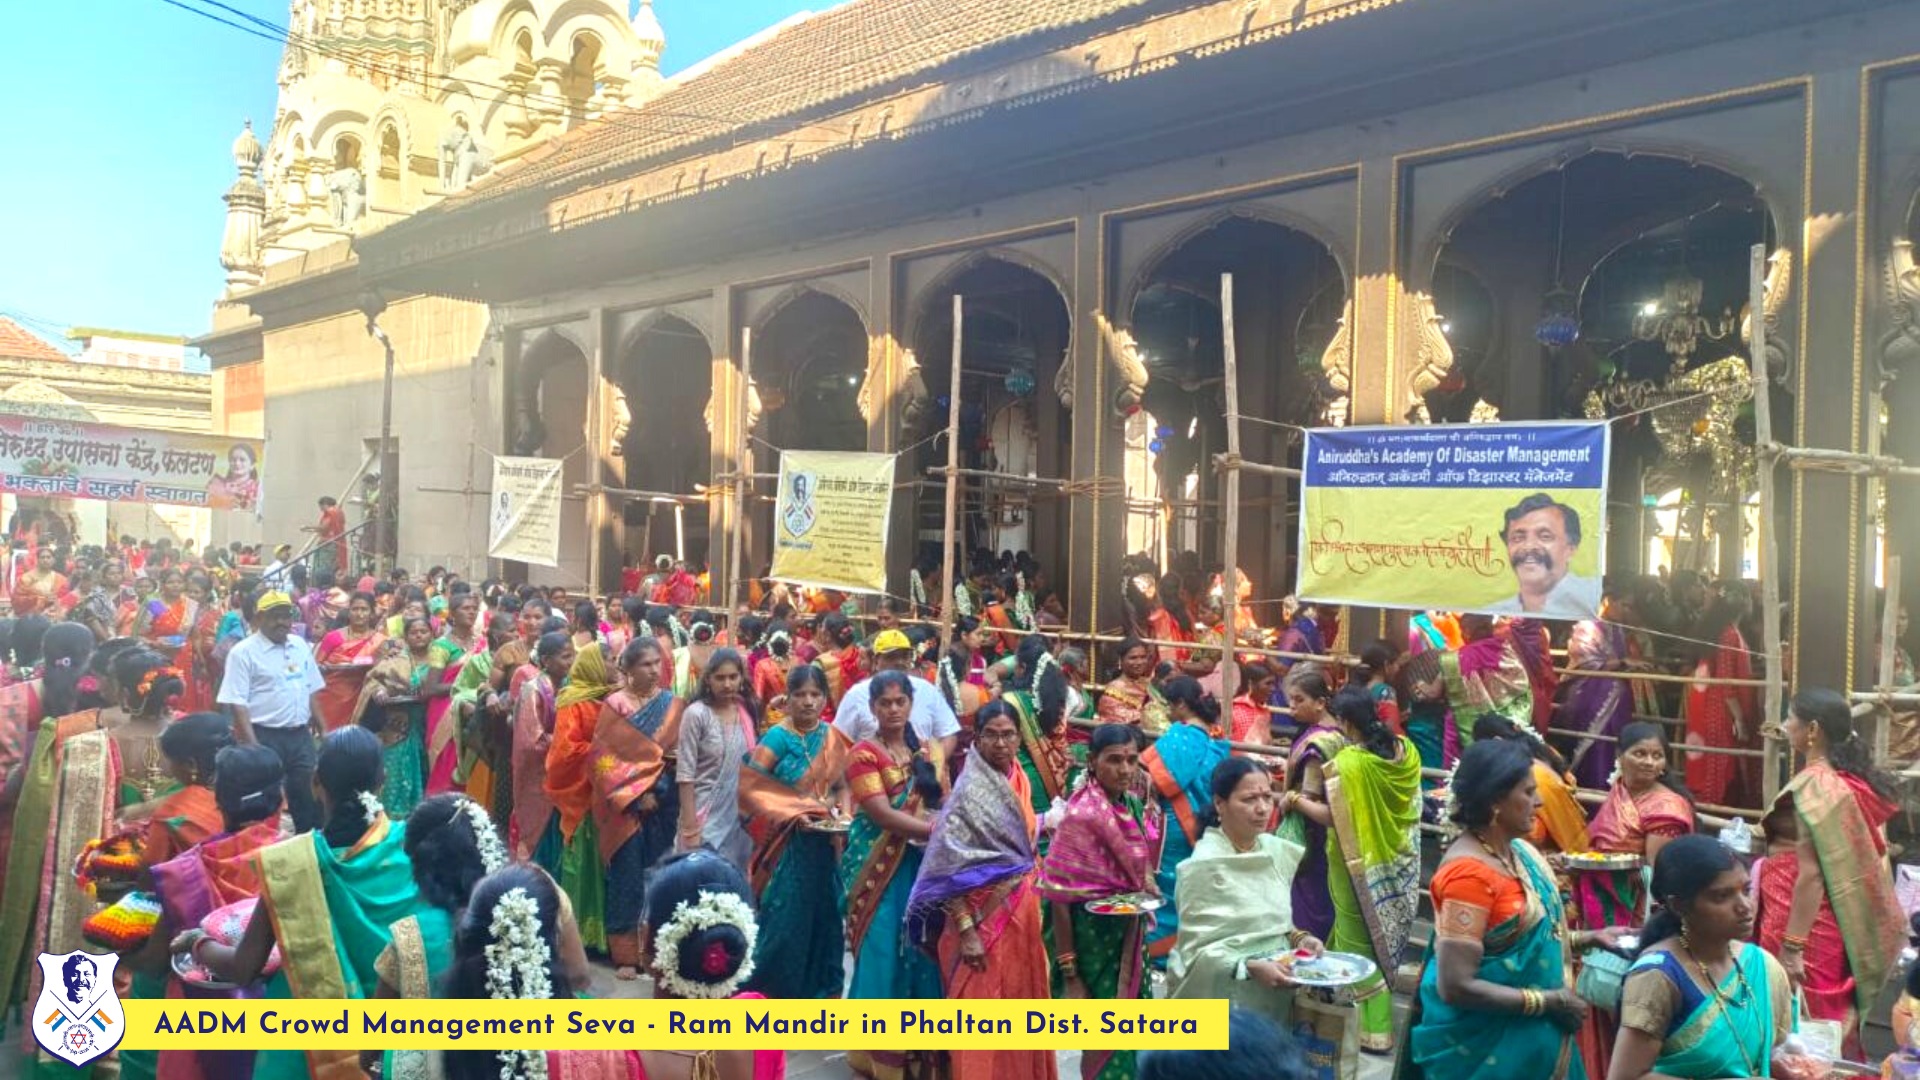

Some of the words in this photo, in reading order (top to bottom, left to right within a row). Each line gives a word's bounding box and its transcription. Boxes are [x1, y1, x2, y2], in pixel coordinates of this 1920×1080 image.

[53, 439, 121, 467] उपासना
[161, 450, 216, 476] फलटण
[1318, 448, 1379, 464] Aniruddha's
[1381, 447, 1434, 468] Academy
[1436, 447, 1451, 463] Of
[1454, 447, 1505, 463] Disaster
[1506, 445, 1591, 467] Management
[88, 480, 141, 499] सहर्ष
[145, 485, 208, 503] स्वागत
